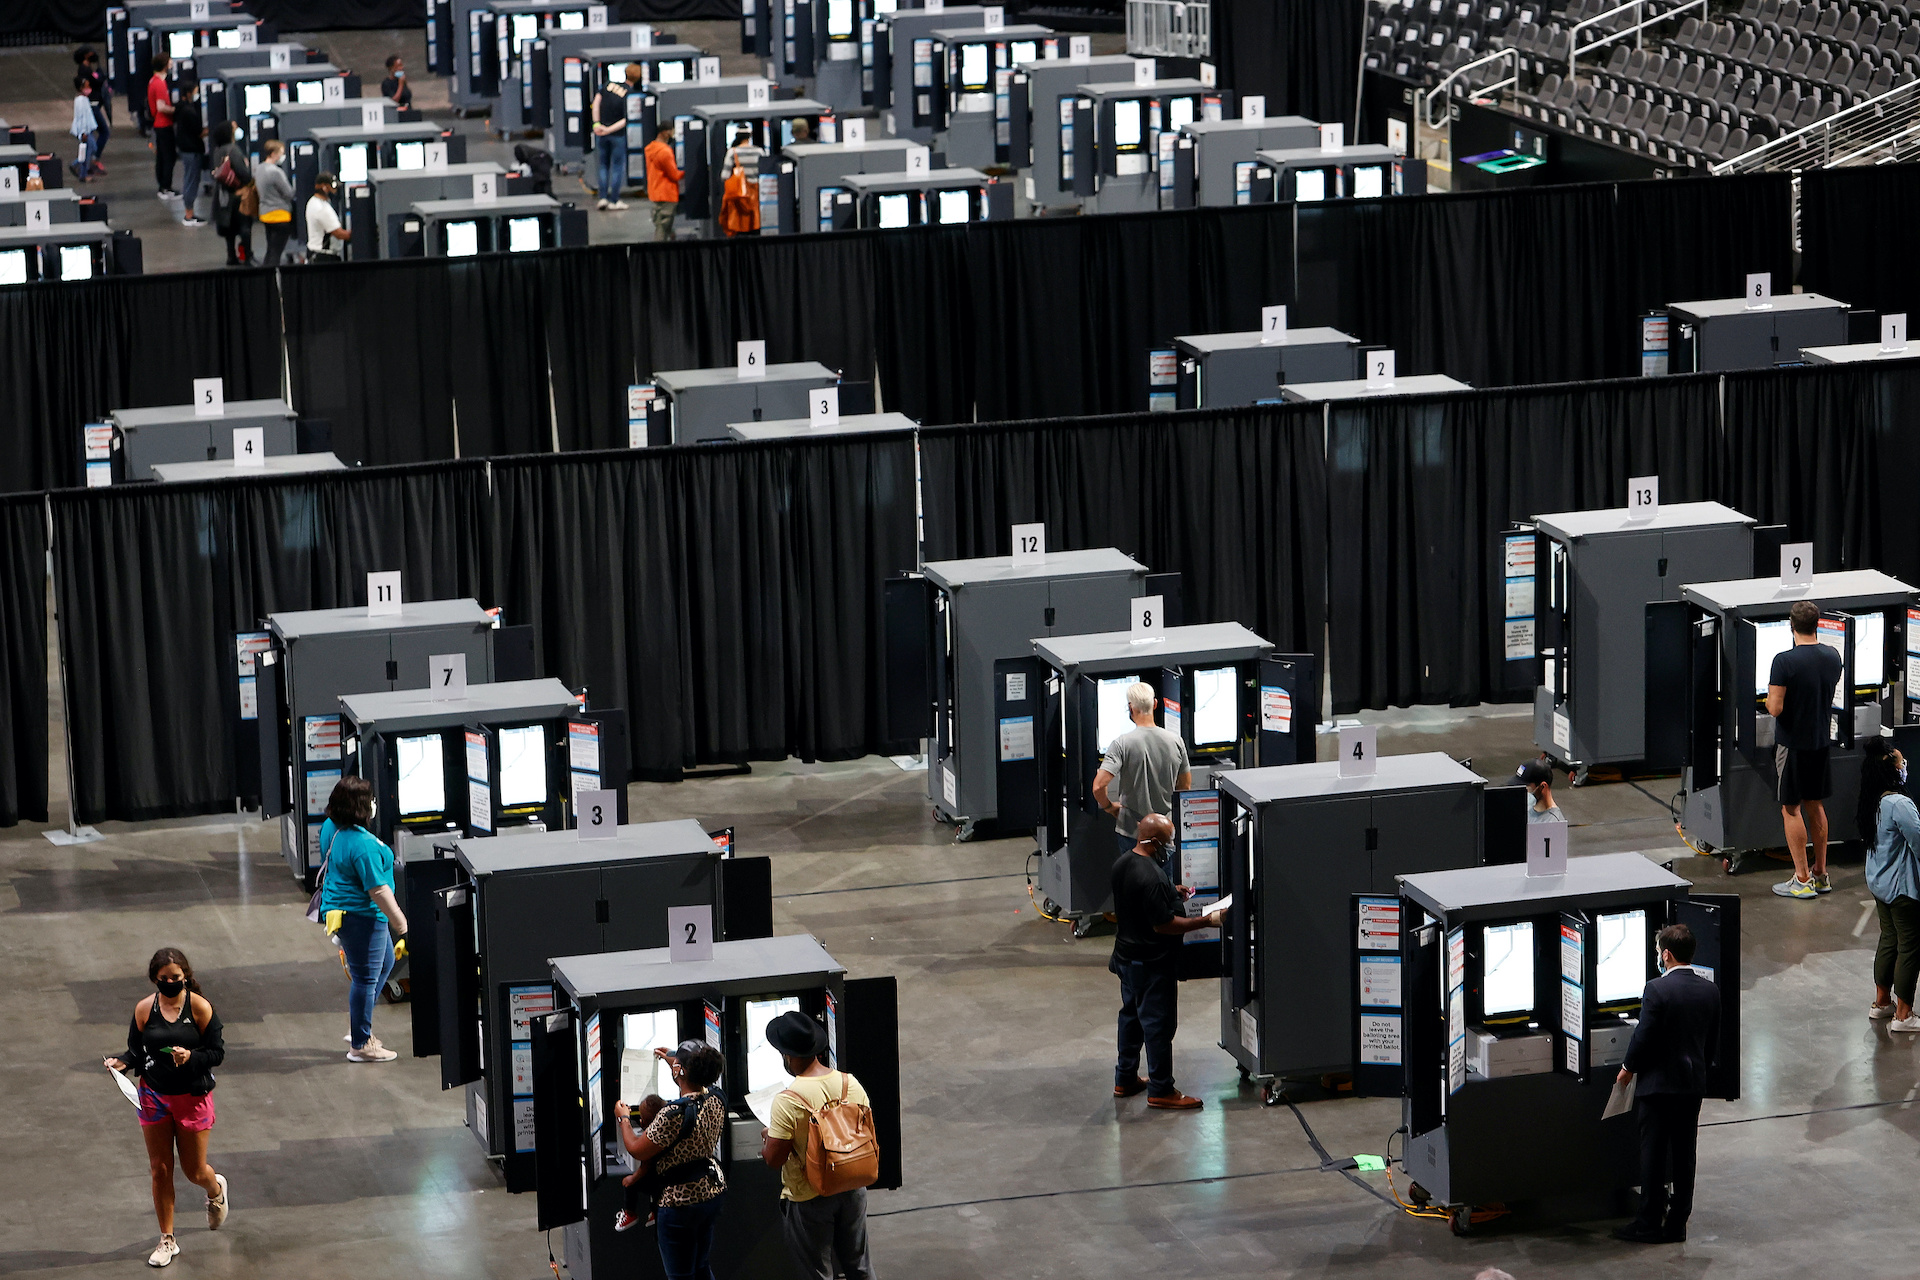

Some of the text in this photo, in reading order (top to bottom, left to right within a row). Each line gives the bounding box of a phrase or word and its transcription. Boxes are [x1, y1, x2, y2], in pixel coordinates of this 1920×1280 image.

[754, 88, 764, 98] 10
[1252, 104, 1258, 116] 5
[850, 128, 856, 138] 6
[434, 152, 438, 162] 7
[914, 156, 922, 168] 2
[4, 178, 10, 188] 8
[482, 182, 488, 194] 3
[34, 210, 42, 222] 4
[1756, 284, 1762, 296] 8
[1272, 317, 1277, 330] 7
[1892, 326, 1895, 338] 1
[748, 352, 755, 365] 6
[1378, 362, 1384, 375] 2
[206, 390, 212, 403] 5
[821, 401, 828, 414] 3
[245, 440, 252, 454] 4
[1637, 490, 1651, 505] 13
[1022, 537, 1037, 552] 12
[1793, 557, 1801, 573] 9
[378, 585, 391, 601] 11
[1143, 611, 1151, 627] 8
[444, 669, 452, 686] 7
[1353, 742, 1363, 760] 4
[592, 806, 602, 825] 3
[1544, 838, 1550, 858] 1
[685, 923, 696, 944] 2
